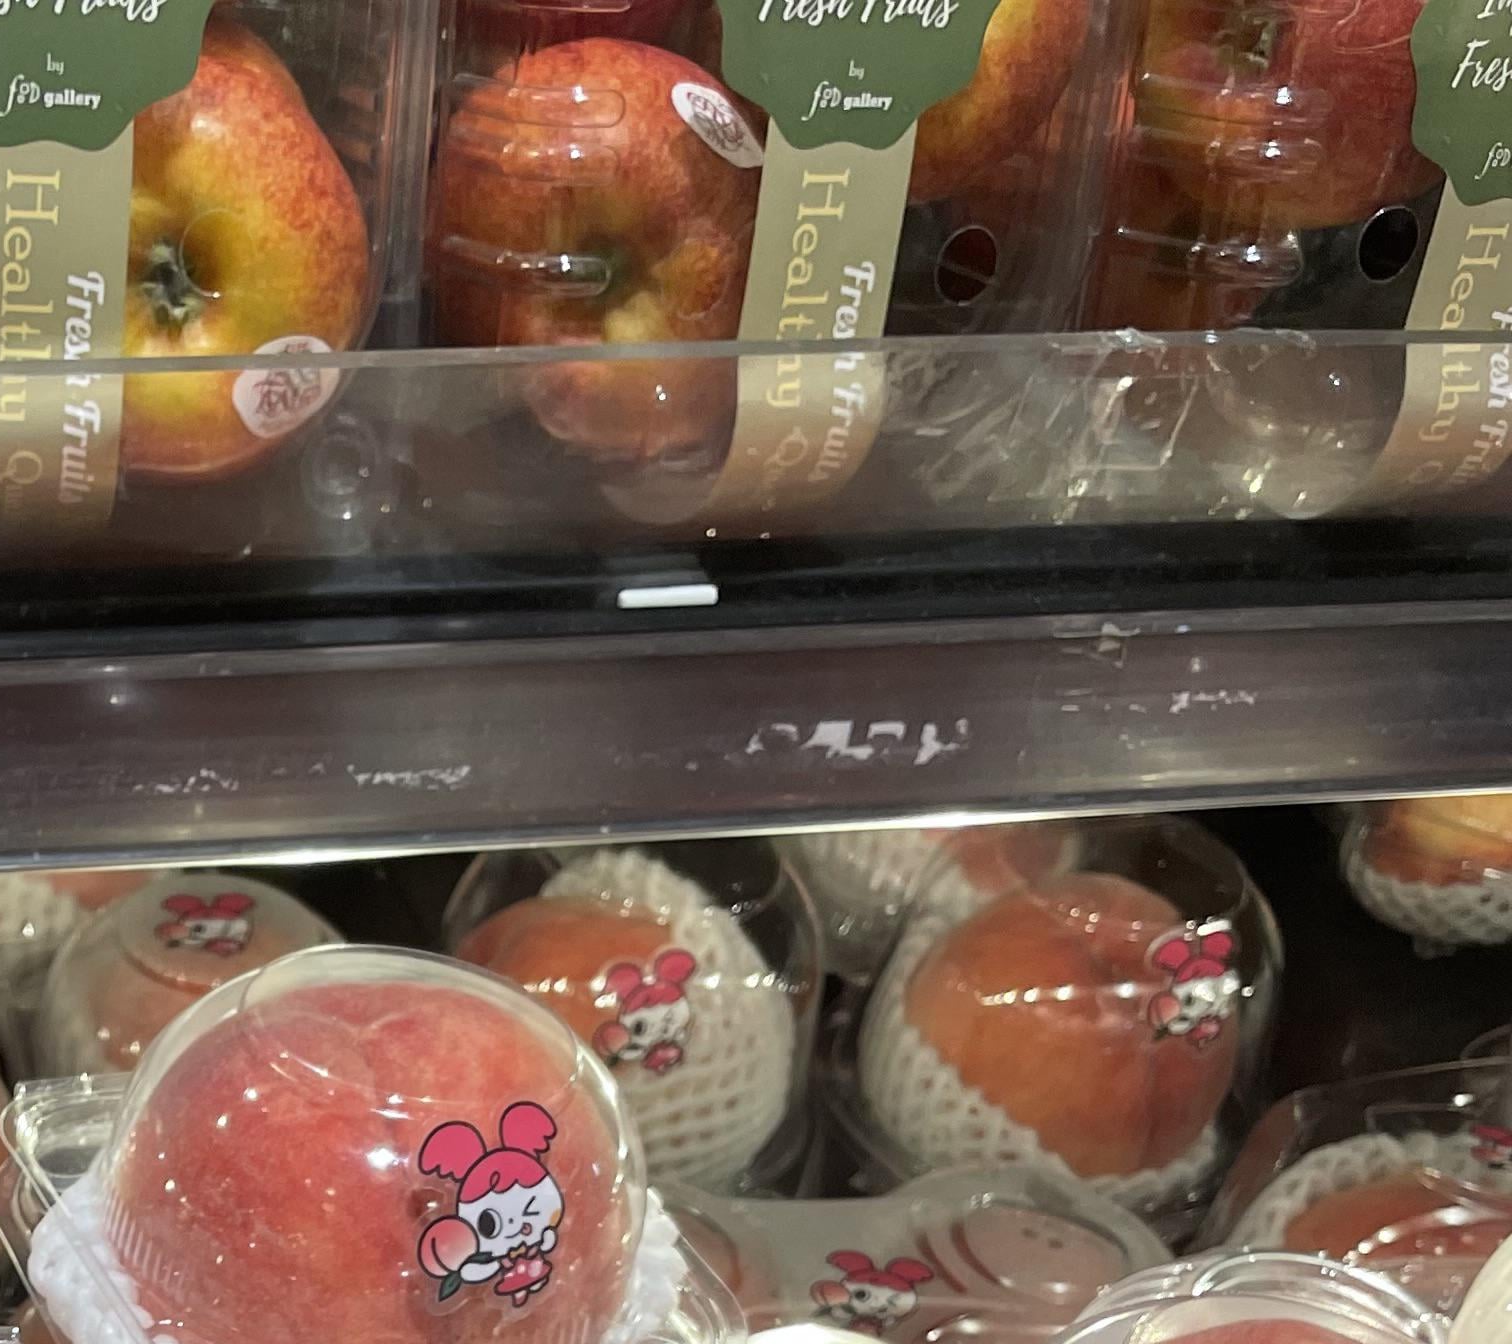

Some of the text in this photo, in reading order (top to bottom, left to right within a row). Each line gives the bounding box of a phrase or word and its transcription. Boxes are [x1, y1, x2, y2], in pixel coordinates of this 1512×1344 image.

[46, 52, 65, 75] by
[848, 60, 865, 80] by
[1451, 38, 1512, 92] Fres
[43, 89, 101, 110] gallery
[843, 93, 893, 111] gallery
[1419, 223, 1510, 443] Healthy
